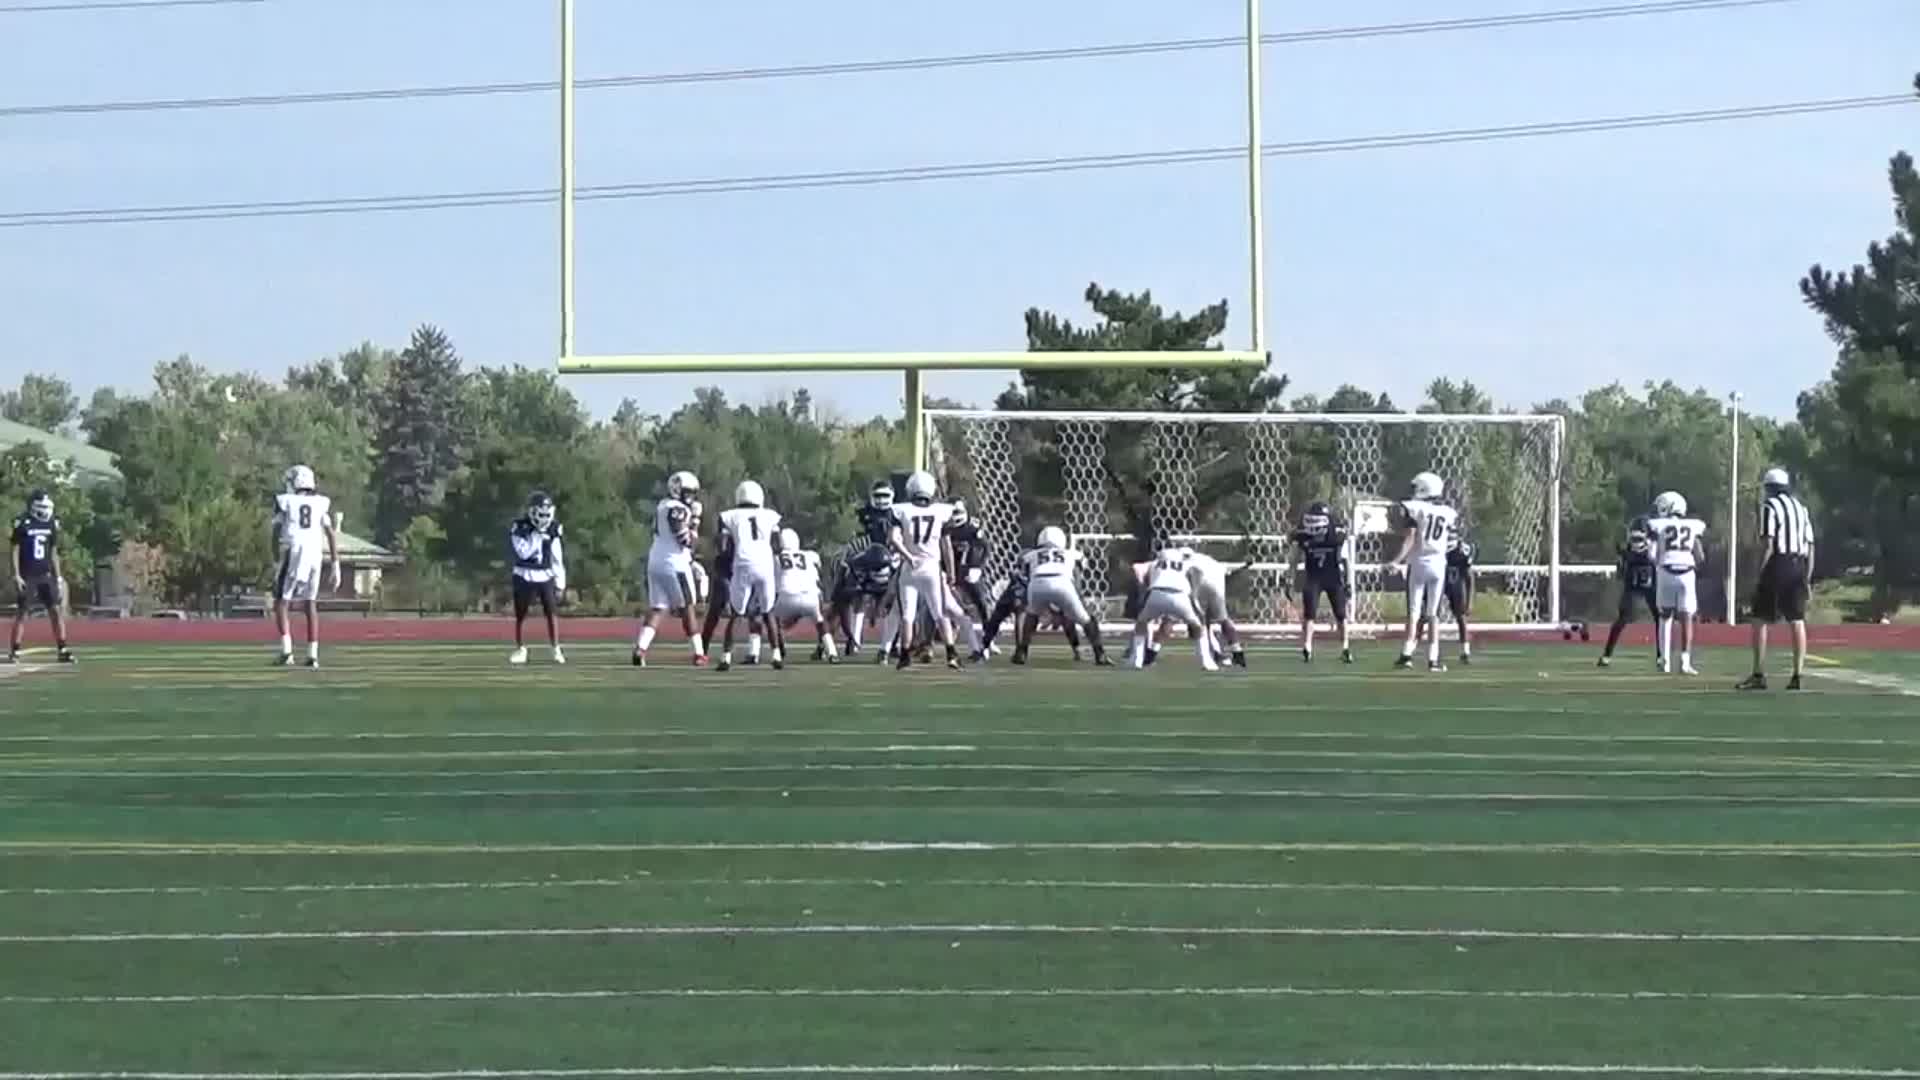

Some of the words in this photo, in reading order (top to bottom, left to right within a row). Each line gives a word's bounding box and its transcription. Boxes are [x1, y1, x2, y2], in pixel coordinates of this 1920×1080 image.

[299, 504, 312, 529] 8
[747, 515, 759, 541] 1
[1425, 513, 1446, 541] 16
[911, 515, 935, 545] 17
[1665, 525, 1691, 551] 22
[33, 535, 47, 559] 6
